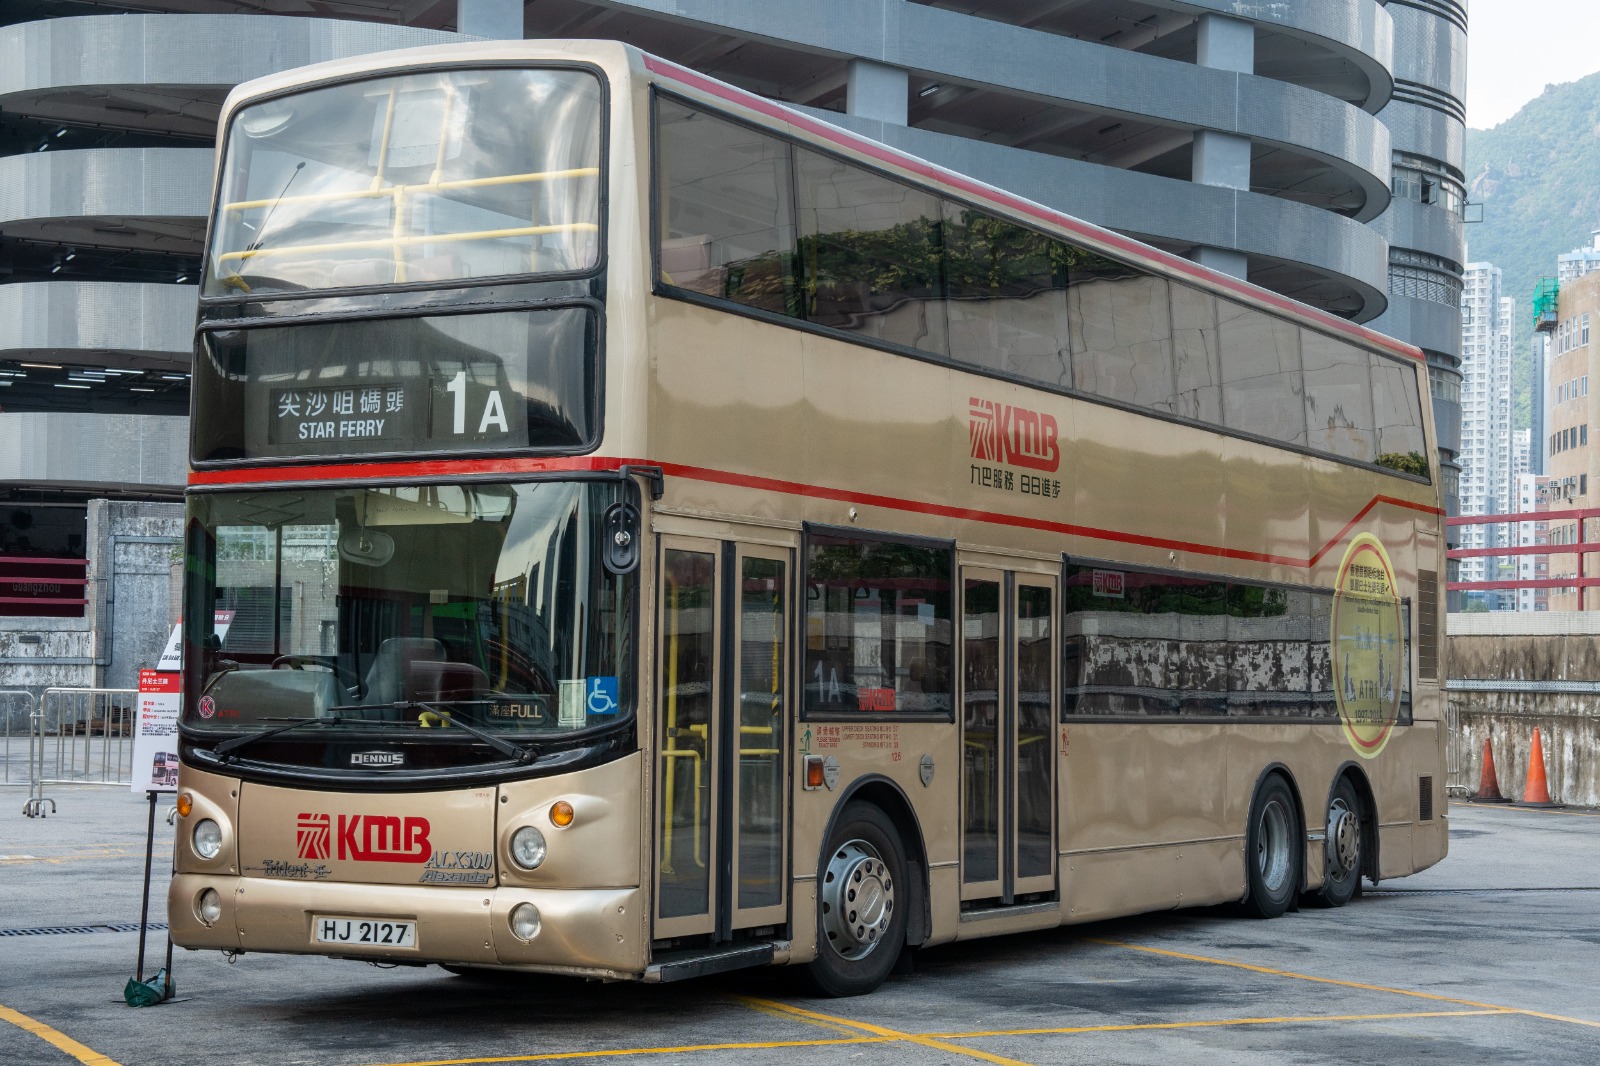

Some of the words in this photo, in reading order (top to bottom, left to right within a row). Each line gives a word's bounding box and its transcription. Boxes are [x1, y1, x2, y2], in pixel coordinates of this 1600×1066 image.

[278, 387, 404, 418] 尖沙咀碼頭
[447, 371, 510, 434] 1A
[299, 421, 335, 439] STAR
[340, 419, 385, 437] FERRY
[995, 402, 1060, 473] KMB
[970, 464, 1014, 491] 九巴服務
[1020, 474, 1061, 499] 日日進步
[12, 582, 61, 596] Guangzhou
[1103, 573, 1122, 594] KMB
[814, 660, 842, 702] 1A
[1359, 680, 1378, 700] ATR1
[870, 687, 896, 711] KMB
[510, 704, 543, 718] FULL
[351, 753, 404, 764] DENNIS
[891, 752, 901, 761] 126
[337, 814, 432, 863] KMB
[262, 860, 309, 878] Trident
[424, 851, 493, 870] ALX500
[419, 870, 494, 884] Alexander
[323, 920, 351, 941] HJ
[359, 922, 408, 944] 2127
